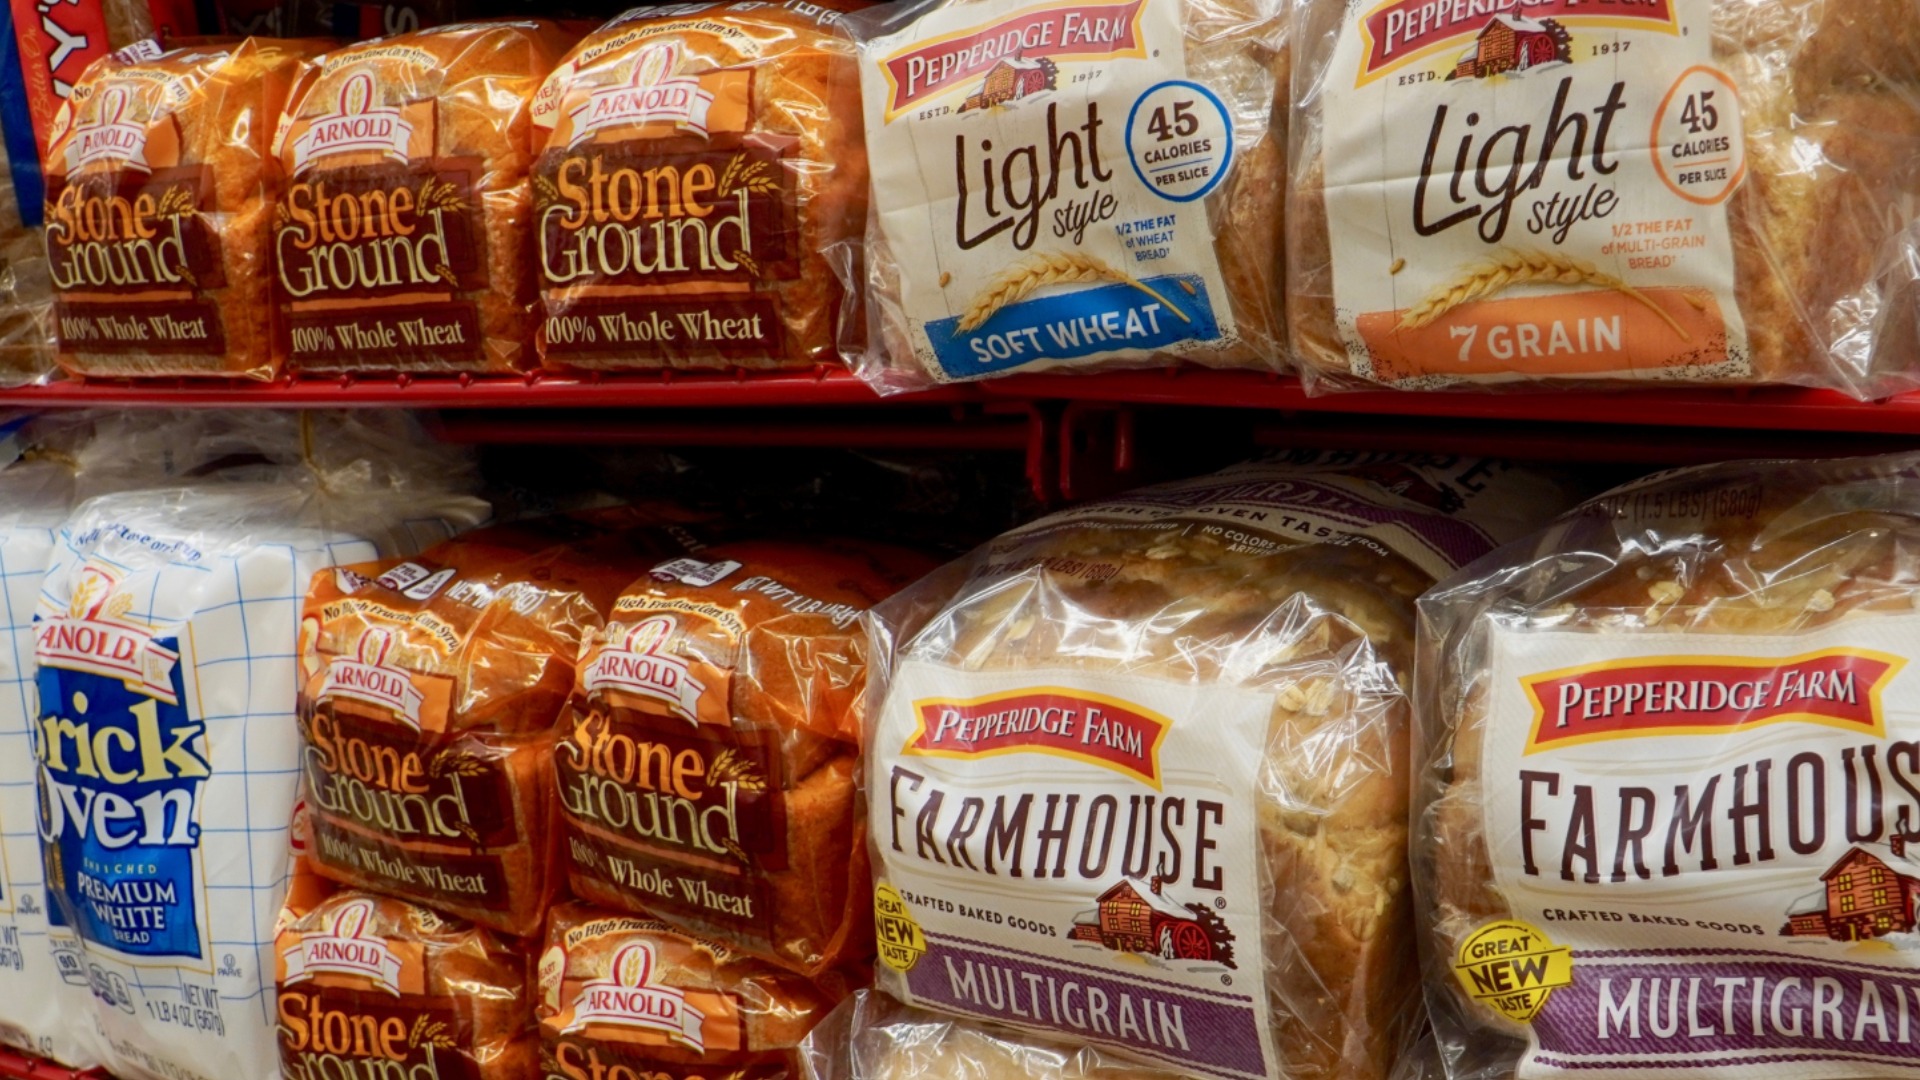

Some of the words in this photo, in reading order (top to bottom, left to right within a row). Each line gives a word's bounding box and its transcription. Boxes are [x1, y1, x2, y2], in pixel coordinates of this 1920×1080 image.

[583, 47, 602, 62] No
[604, 33, 637, 51] High
[905, 17, 1053, 97] PEPPERIDGE
[1059, 11, 1127, 48] FARM
[1591, 41, 1631, 57] 1937
[1072, 69, 1103, 83] 1937
[1399, 71, 1442, 86] ESTD.
[594, 86, 687, 117] ARNOLD
[918, 104, 955, 121] ESTD.
[1680, 90, 1719, 134] 45
[311, 119, 392, 147] ARNOLD
[1146, 100, 1200, 142] 45
[82, 128, 137, 152] ARNOLD
[1144, 139, 1212, 165] CALORIES
[1671, 136, 1730, 159] CALORIES
[956, 101, 1113, 250] Light
[1155, 171, 1176, 187] PER
[1177, 164, 1210, 183] SLICE
[1413, 76, 1626, 244] Light
[1679, 170, 1702, 186] PER
[1703, 167, 1728, 183] SLICE
[558, 156, 716, 230] Stone
[57, 183, 156, 246] Stone
[289, 181, 416, 250] Stone
[1053, 190, 1119, 246] style
[1115, 222, 1133, 237] 1/2
[1133, 218, 1154, 232] THE
[1155, 215, 1177, 229] FAT
[1526, 183, 1620, 245] style
[1611, 223, 1635, 239] 1/2
[1635, 220, 1664, 235] THE
[1665, 218, 1693, 233] FAT
[45, 213, 188, 290] Ground
[276, 206, 449, 298] Ground
[540, 187, 751, 284] Ground
[1125, 236, 1136, 249] of
[1136, 230, 1175, 248] WHEAT
[1601, 243, 1615, 256] of
[1615, 235, 1706, 254] MULTI-GRAIN
[61, 316, 98, 341] 100%
[99, 315, 150, 341] Whole
[151, 314, 207, 340] Wheat
[291, 326, 335, 353] 100%
[335, 322, 396, 350] Whole
[397, 318, 466, 346] Wheat
[546, 315, 596, 345] 100%
[598, 311, 676, 342] Whole
[677, 309, 764, 342] Wheat
[970, 325, 1050, 365] SOFT
[1045, 303, 1163, 347] WHEAT
[1450, 324, 1479, 362] 7
[1486, 314, 1622, 358] GRAIN
[1199, 506, 1268, 523] OVEN
[1634, 493, 1662, 521] (1.5
[1668, 489, 1708, 519] LBS)
[1713, 485, 1763, 520] (680g)
[1202, 524, 1222, 536] NO
[1223, 528, 1277, 550] COLORS
[323, 606, 340, 621] No
[37, 624, 137, 664] ANOLD
[596, 655, 678, 689] ARNOLD
[1555, 679, 1771, 728] PEPPERIDGE
[1773, 669, 1857, 708] FARM
[933, 707, 1077, 743] PEPPERIDGE
[1081, 707, 1143, 759] FARM
[312, 713, 429, 793] Stone
[567, 709, 705, 800] Stone
[35, 761, 196, 849] Oven
[304, 745, 471, 837] Ground
[554, 739, 740, 854] Ground
[890, 765, 1224, 891] FARMHOUSE
[1519, 740, 1920, 884] FARMHOUS
[77, 871, 177, 904] PREMIUM
[359, 847, 417, 884] Whole
[416, 864, 489, 895] Wheat
[607, 854, 675, 898] Whole
[676, 875, 755, 918] Wheat
[91, 901, 166, 930] WHITE
[877, 915, 914, 946] NEW
[900, 889, 955, 914] CRAFTED
[959, 904, 1003, 924] BAKED
[1007, 915, 1057, 937] GOODS
[1542, 907, 1623, 923] CRAFTED
[1628, 911, 1690, 927] BAKED
[1695, 919, 1766, 936] GOODS
[112, 929, 150, 944] BREAD
[568, 931, 583, 948] No
[585, 920, 617, 937] High
[1471, 936, 1531, 959] GREAT
[307, 943, 380, 966] ARNOLD
[881, 943, 909, 963] TASTE
[1467, 955, 1549, 994] NEW
[183, 982, 201, 1006] NET
[201, 986, 219, 1010] WT
[588, 991, 677, 1019] ARNOLD
[945, 955, 1191, 1053] MULTIGRAIN
[1597, 976, 1920, 1044] MULTIGRAI
[146, 1000, 156, 1019] 1
[155, 1000, 171, 1022] LB
[172, 1003, 178, 1023] 4
[179, 1005, 194, 1028] OZ
[279, 992, 408, 1062] Stone
